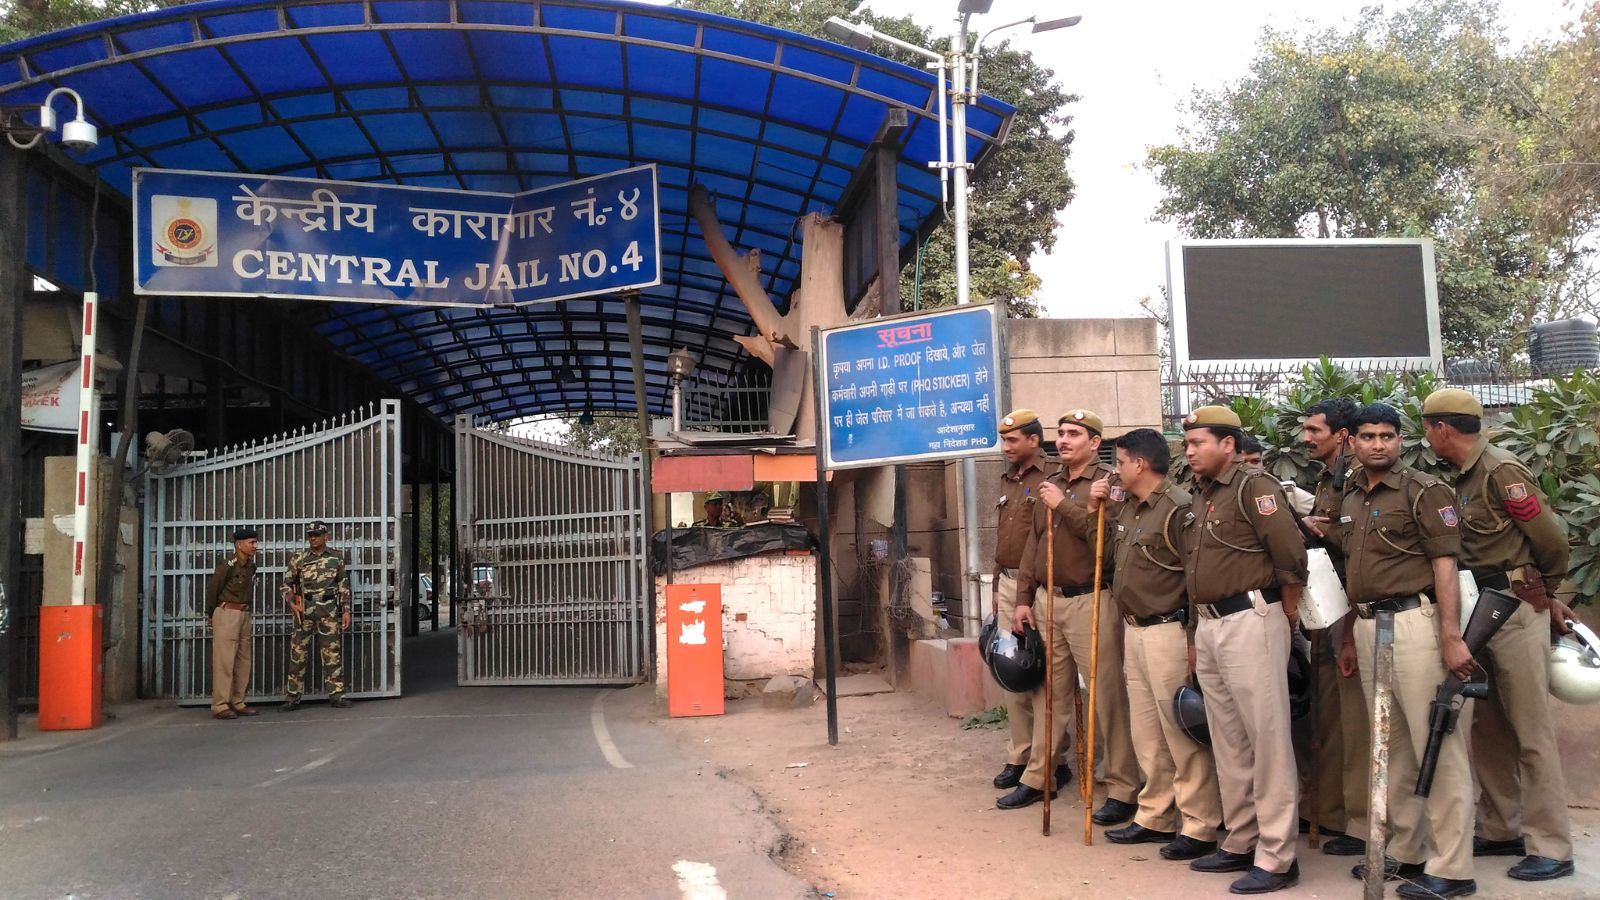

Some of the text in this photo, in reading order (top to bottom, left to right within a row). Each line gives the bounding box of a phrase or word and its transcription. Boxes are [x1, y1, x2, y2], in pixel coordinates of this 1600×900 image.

[232, 184, 376, 233] केन्द्रीय
[409, 205, 556, 241] कारागार
[232, 249, 450, 289] CENTRAL
[464, 259, 549, 291] JAIL
[877, 322, 932, 347] सूचना
[833, 362, 850, 379] कृपया
[856, 358, 874, 371] अपना
[894, 352, 921, 367] PROOF
[952, 343, 966, 357] और
[971, 339, 985, 356] जेल
[832, 383, 857, 403] कर्मचारी
[859, 380, 878, 398] अपनी
[898, 381, 908, 393] पर
[975, 366, 988, 384] होने
[834, 415, 843, 427] पर
[846, 410, 853, 428] ही
[856, 409, 868, 425] जेल
[872, 404, 893, 423] परिसर
[905, 407, 915, 419] जा
[918, 401, 937, 418] सकते
[951, 399, 973, 415] अन्यथा
[937, 423, 975, 435] आदेशानुसार
[944, 438, 968, 448] निदेशक
[971, 437, 988, 445] PHQ
